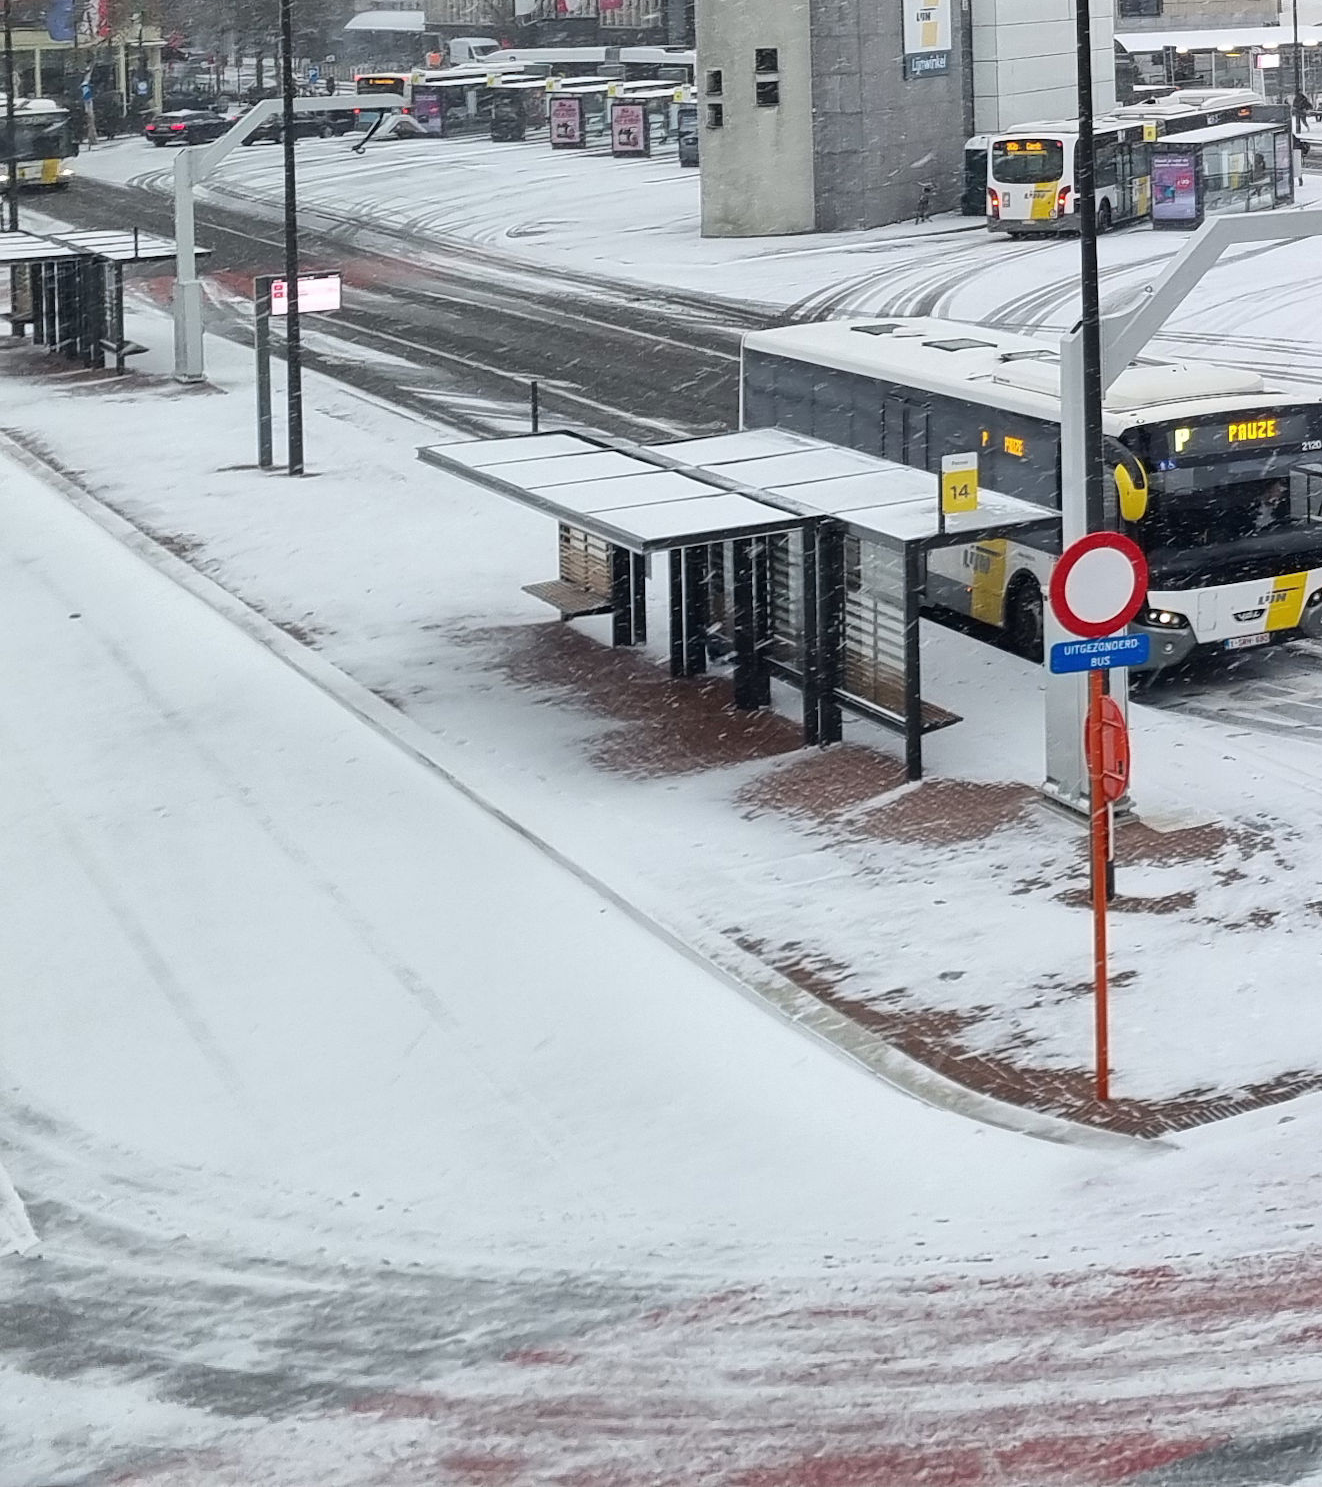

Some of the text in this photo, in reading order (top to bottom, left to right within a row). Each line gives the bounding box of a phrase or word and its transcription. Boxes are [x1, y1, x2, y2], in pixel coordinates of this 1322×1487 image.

[1174, 420, 1277, 453] P PAUZE
[1301, 440, 1322, 451] 2120
[950, 483, 970, 500] 14
[1063, 638, 1139, 656] UITGEZONDERD
[1090, 656, 1111, 667] BUS
